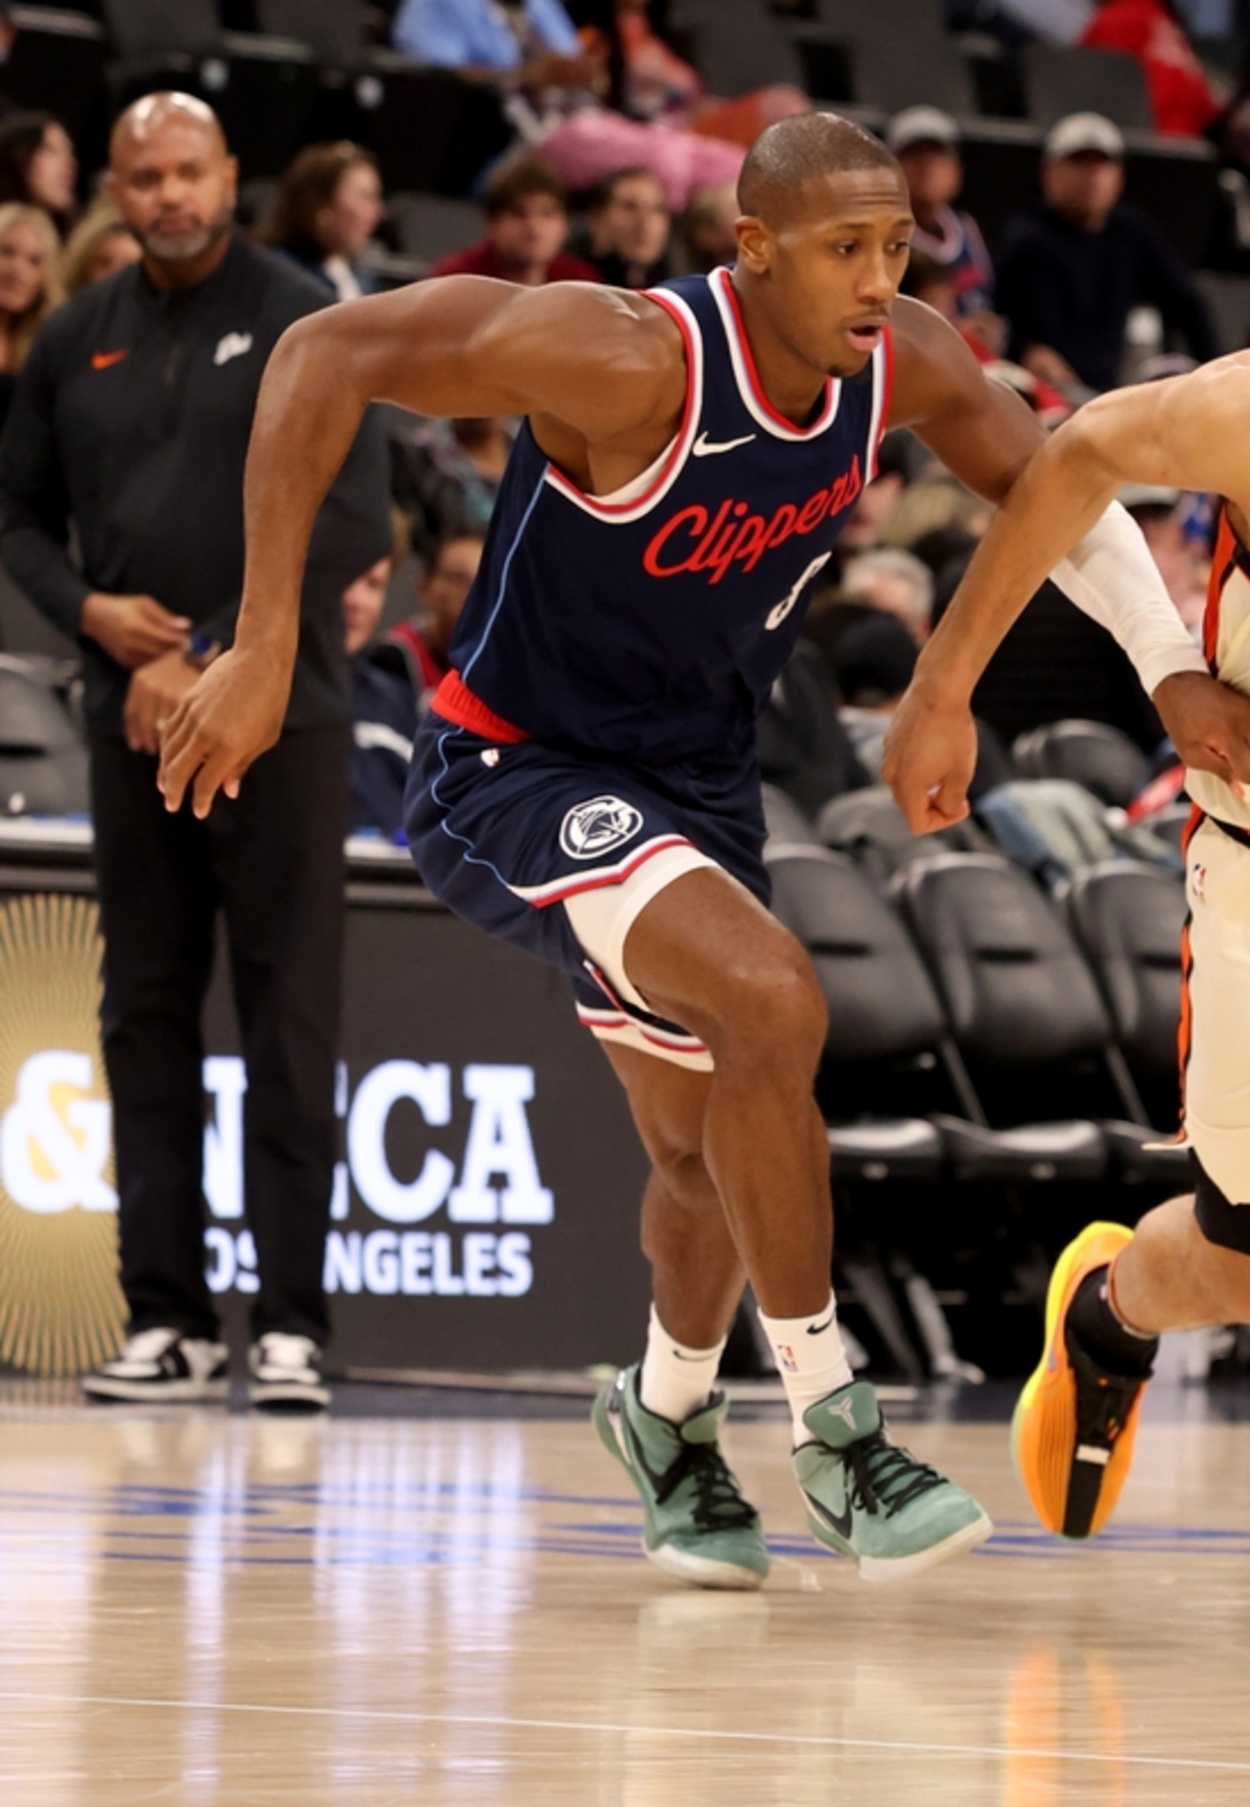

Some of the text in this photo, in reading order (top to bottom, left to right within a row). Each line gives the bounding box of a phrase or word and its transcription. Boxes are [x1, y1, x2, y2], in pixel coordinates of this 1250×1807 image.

[642, 453, 862, 585] Clippers
[0, 1050, 120, 1214] &
[204, 1227, 534, 1297] OS NGELES
